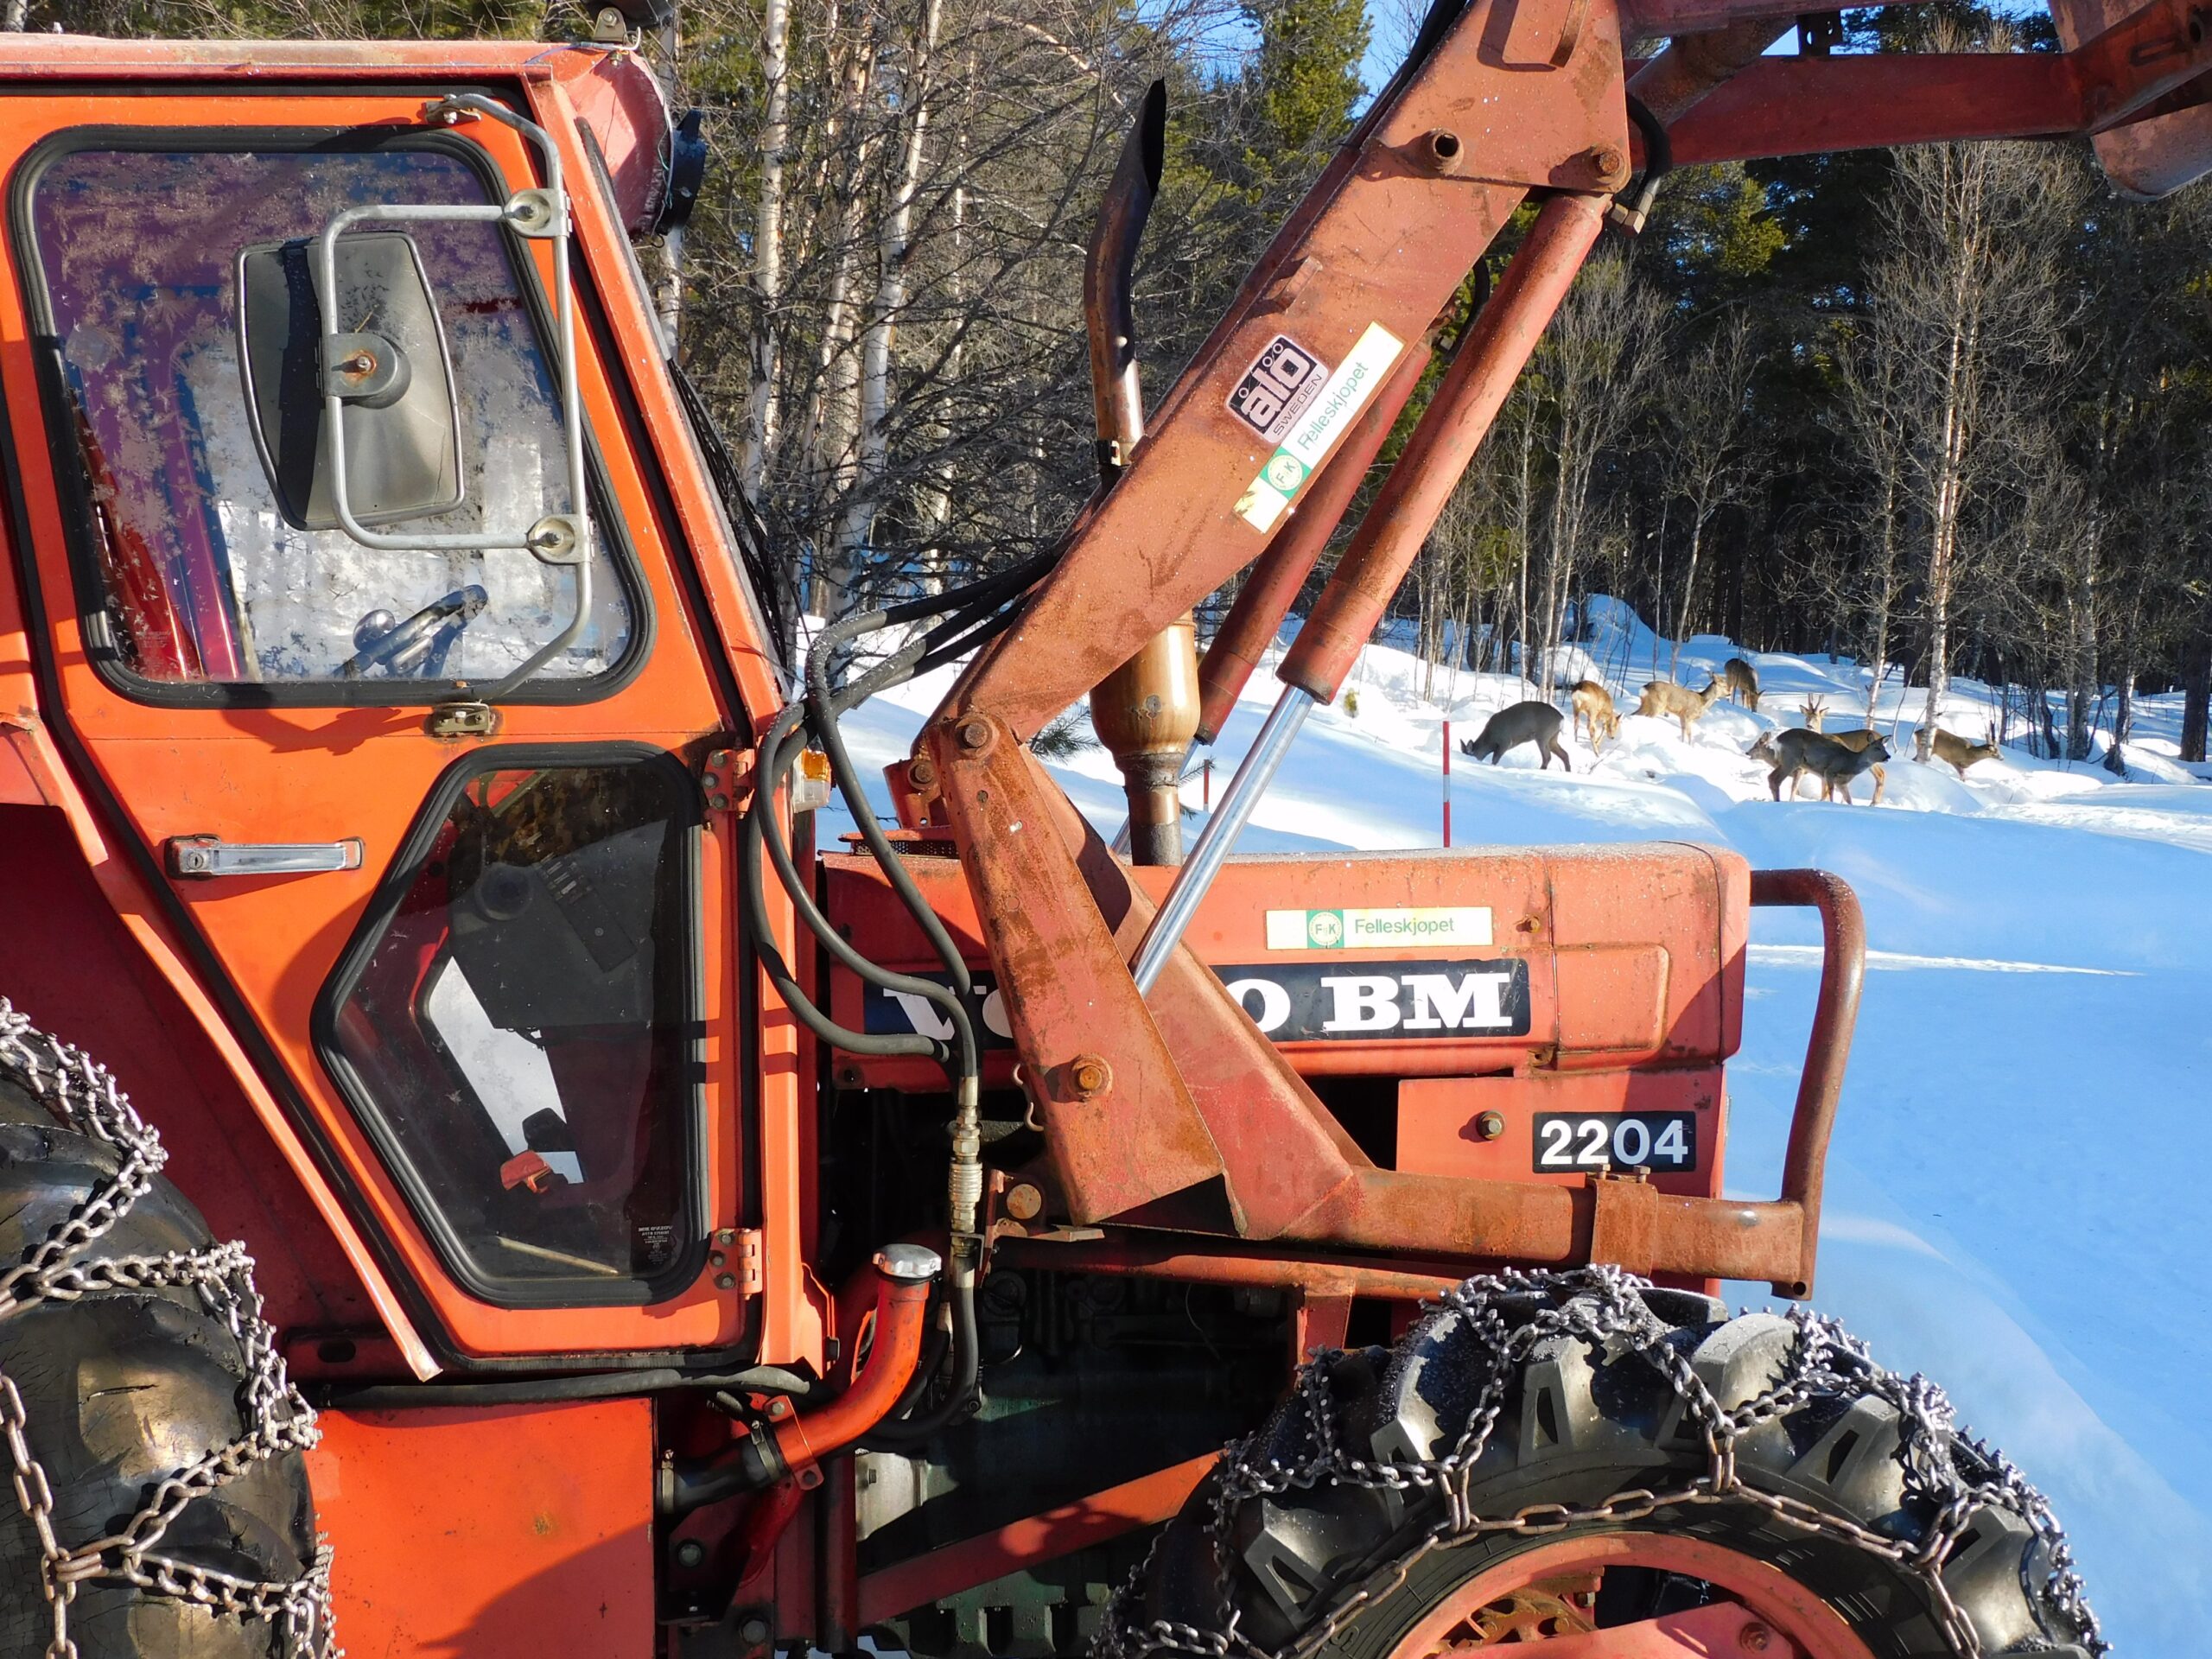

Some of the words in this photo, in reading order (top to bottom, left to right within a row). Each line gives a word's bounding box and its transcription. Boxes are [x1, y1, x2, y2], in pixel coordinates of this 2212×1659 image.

[1274, 374, 1322, 435] SWEDEN
[1320, 973, 1512, 1031] BM
[1541, 1119, 1688, 1165] 2204
